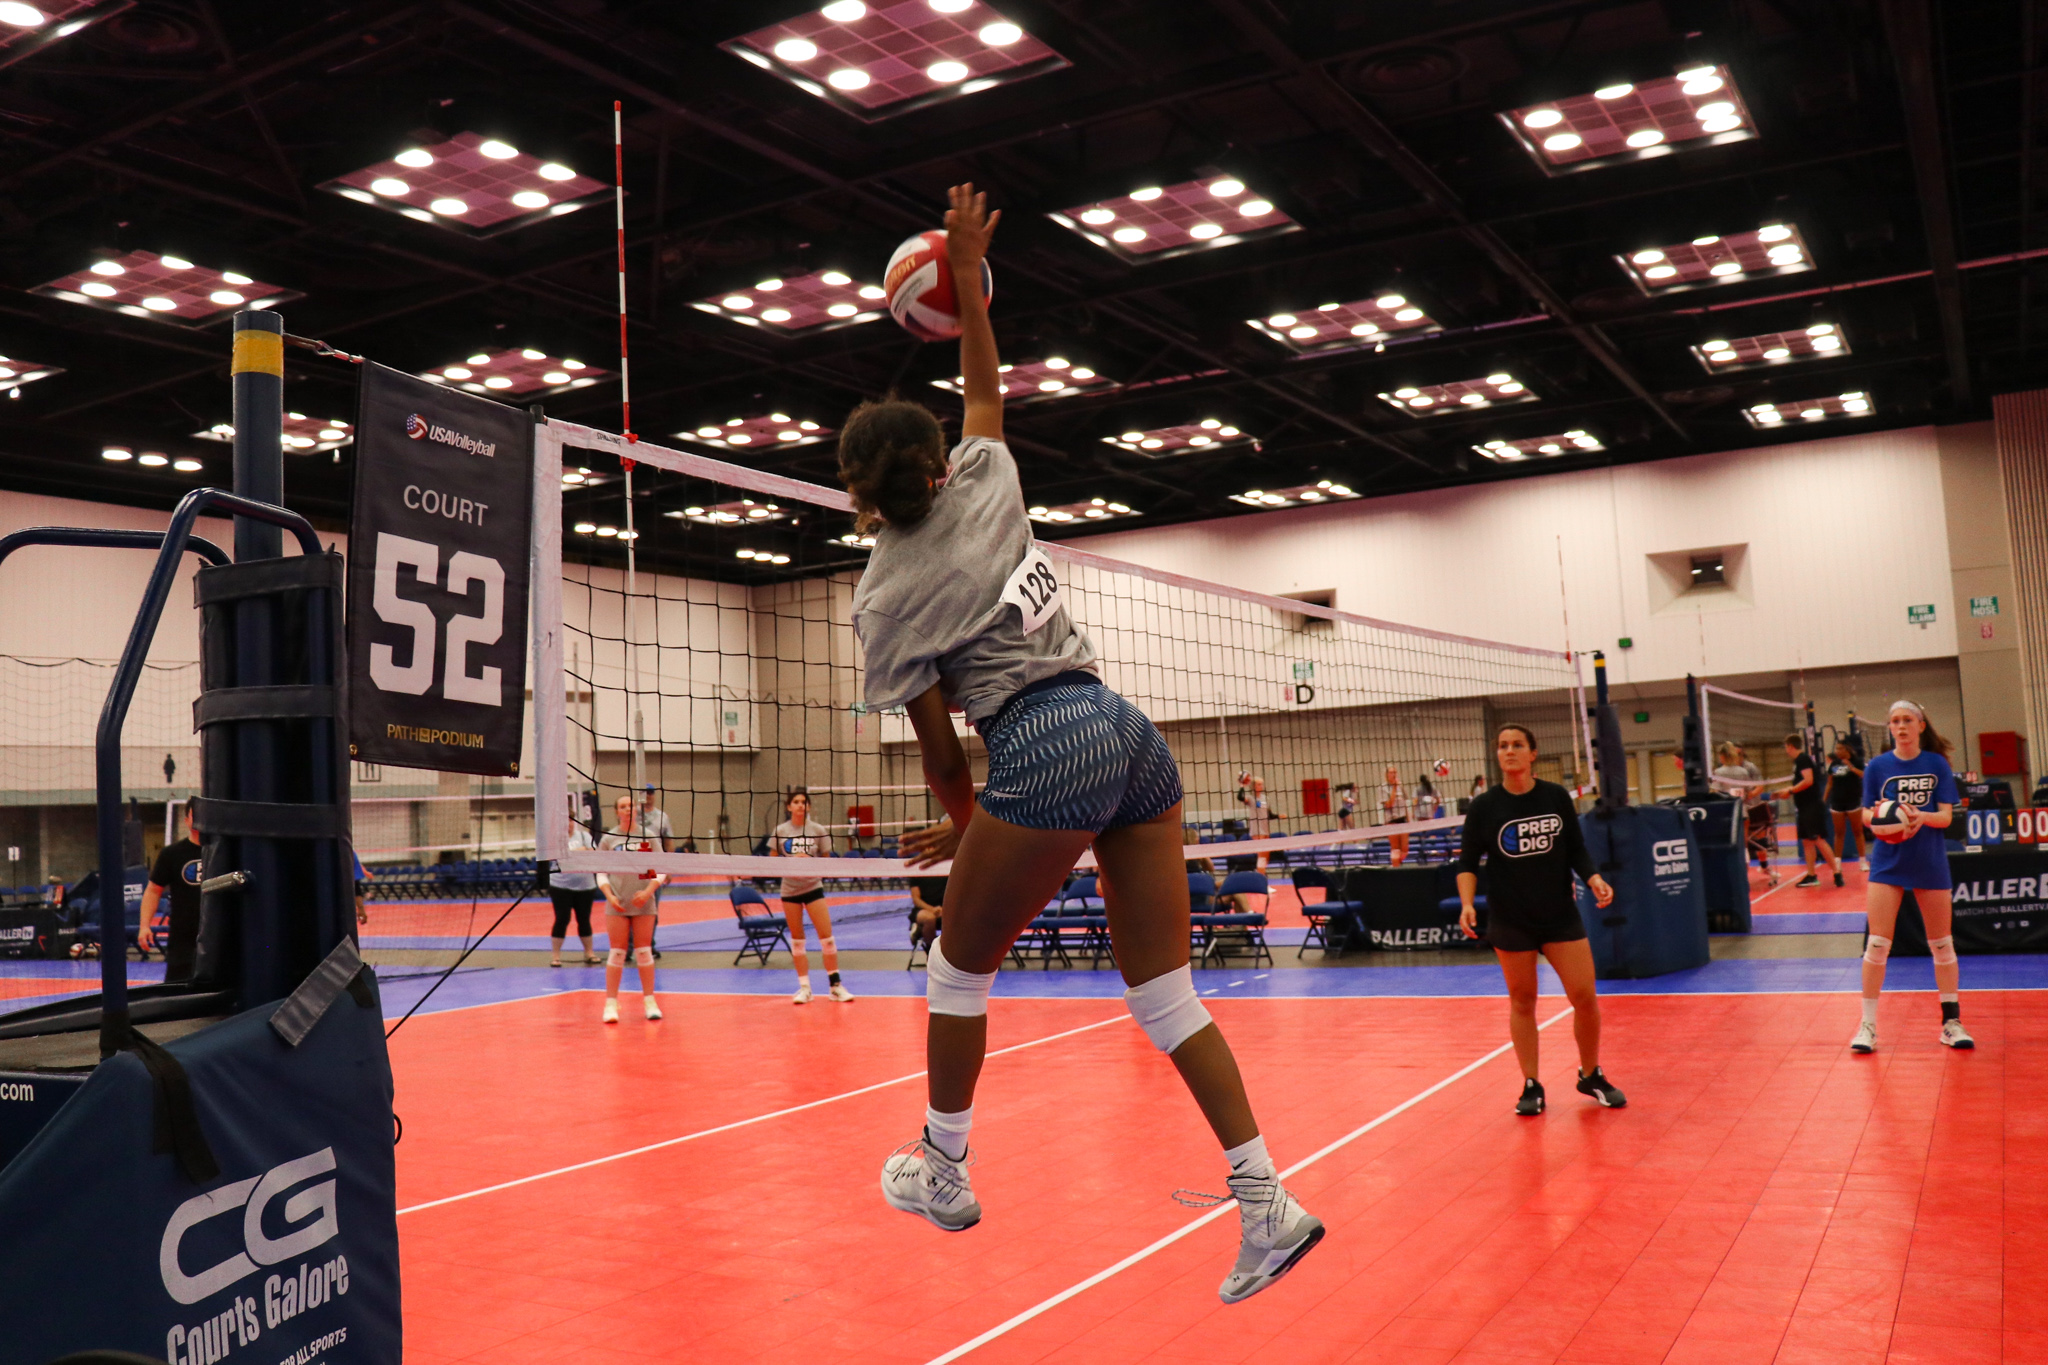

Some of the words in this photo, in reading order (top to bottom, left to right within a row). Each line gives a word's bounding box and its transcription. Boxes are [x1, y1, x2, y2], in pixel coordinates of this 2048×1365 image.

[403, 484, 489, 527] COURT
[1018, 561, 1058, 617] 128
[369, 531, 506, 707] 52
[1296, 684, 1315, 705] D
[1898, 791, 1926, 804] DIG
[1517, 818, 1560, 837] PREP
[1968, 813, 2000, 840] 00
[2006, 814, 2014, 827] 1
[2018, 810, 2048, 838] 00
[1518, 835, 1549, 853] DIG
[1652, 838, 1689, 863] CG
[1952, 876, 2038, 903] ALLER
[1985, 906, 1999, 915] ON
[1370, 927, 1442, 946] BALLER
[0, 1083, 34, 1101] com
[159, 1146, 339, 1305] CG
[166, 1295, 261, 1365] Courts
[264, 1254, 350, 1330] Galore
[296, 1345, 311, 1365] ALL
[310, 1326, 347, 1358] SPORTS
